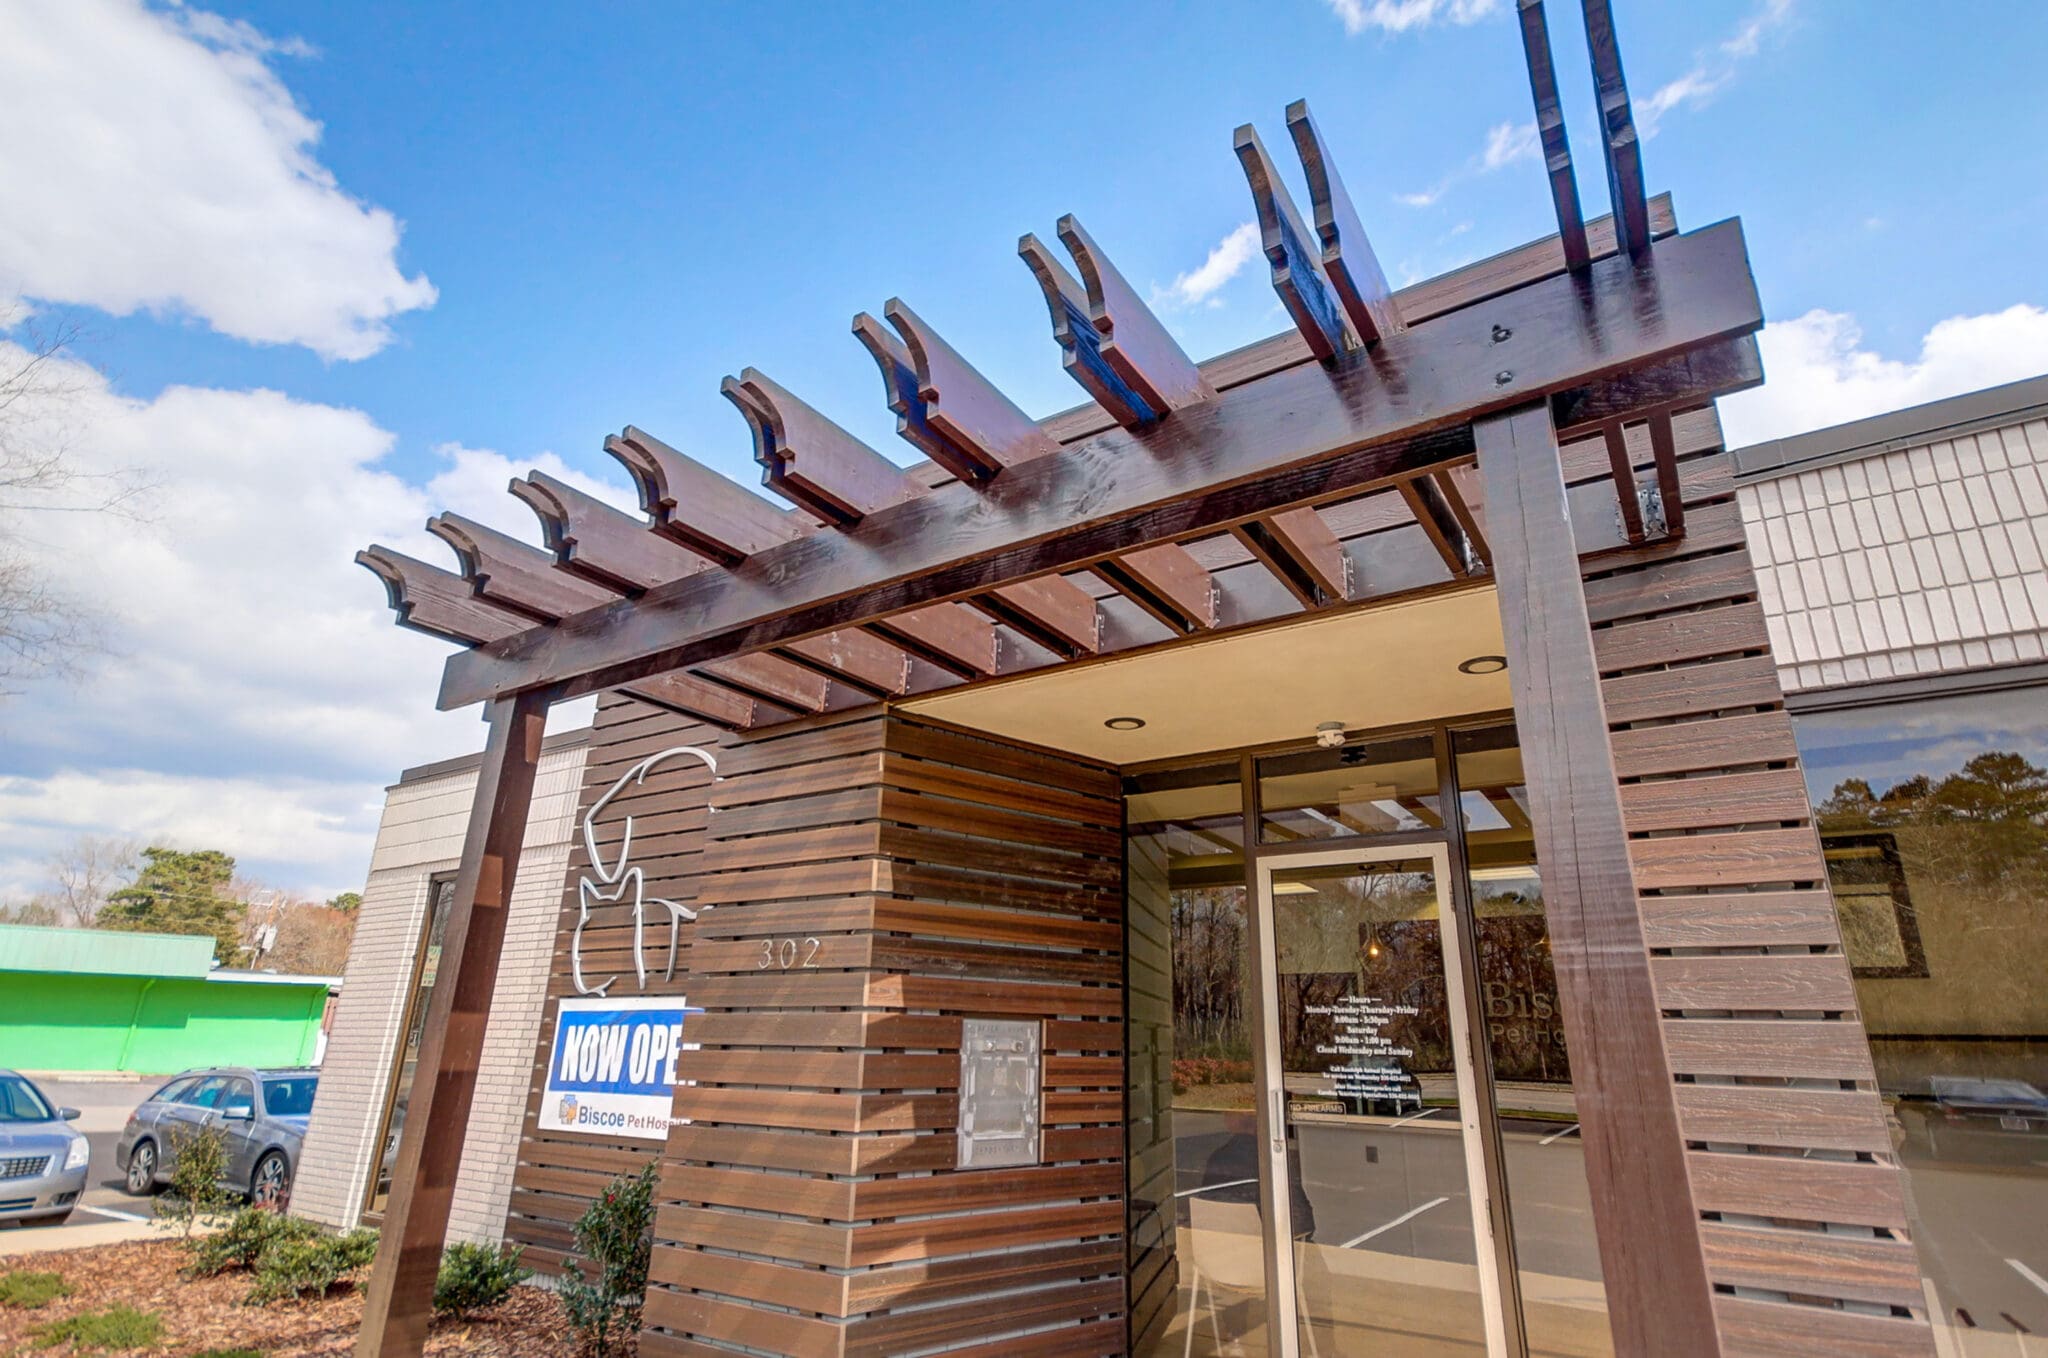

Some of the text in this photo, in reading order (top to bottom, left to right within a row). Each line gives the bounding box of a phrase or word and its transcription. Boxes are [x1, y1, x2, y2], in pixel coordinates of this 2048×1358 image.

[758, 937, 820, 969] 302
[1349, 995, 1370, 1004] Hours
[1347, 1025, 1378, 1037] Saturday
[1535, 1024, 1565, 1045] Ho
[559, 1023, 684, 1085] NOW OPE
[1388, 1047, 1413, 1058] Sunday
[578, 1105, 625, 1127] Biscoe
[627, 1114, 645, 1129] Pet
